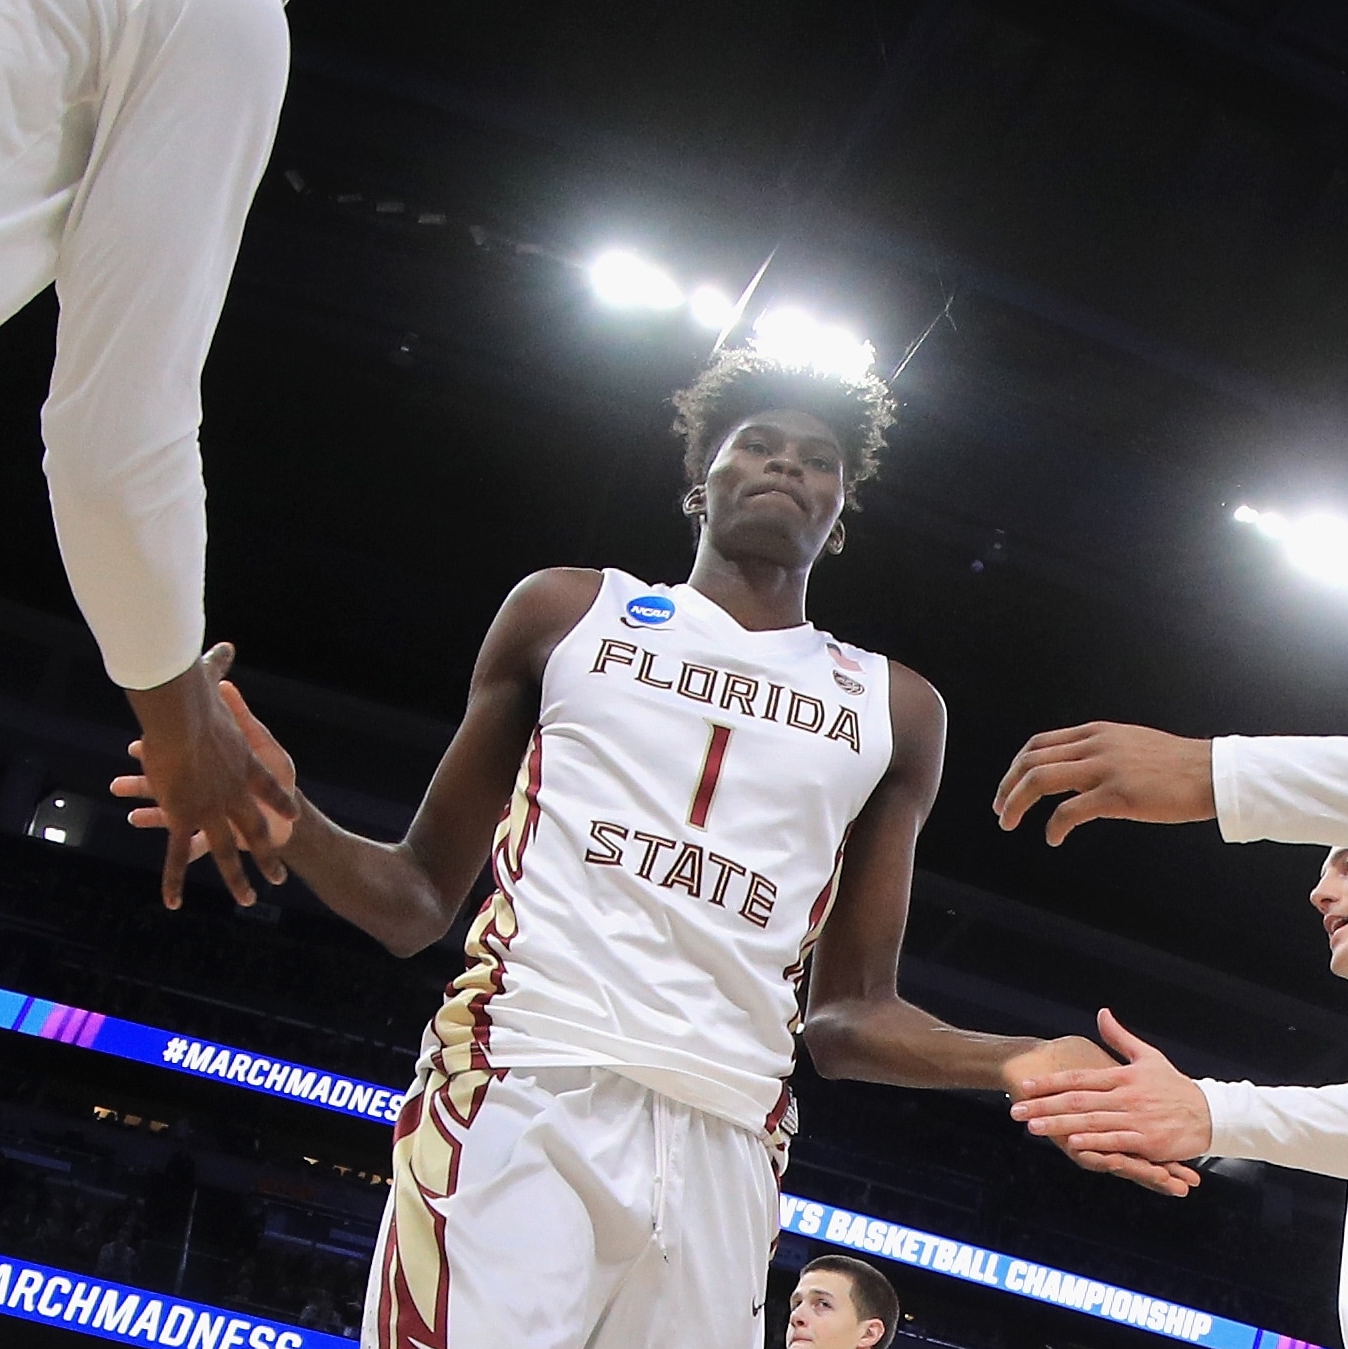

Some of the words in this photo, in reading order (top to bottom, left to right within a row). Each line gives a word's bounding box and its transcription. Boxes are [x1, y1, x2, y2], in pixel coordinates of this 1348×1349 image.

[630, 605, 671, 619] NCAA
[590, 637, 862, 755] FLORIDA
[682, 717, 733, 833] 1
[585, 819, 778, 929] STATE
[825, 1208, 1000, 1286] BASKETBALL
[1005, 1258, 1213, 1342] CHAMPIONSHIP
